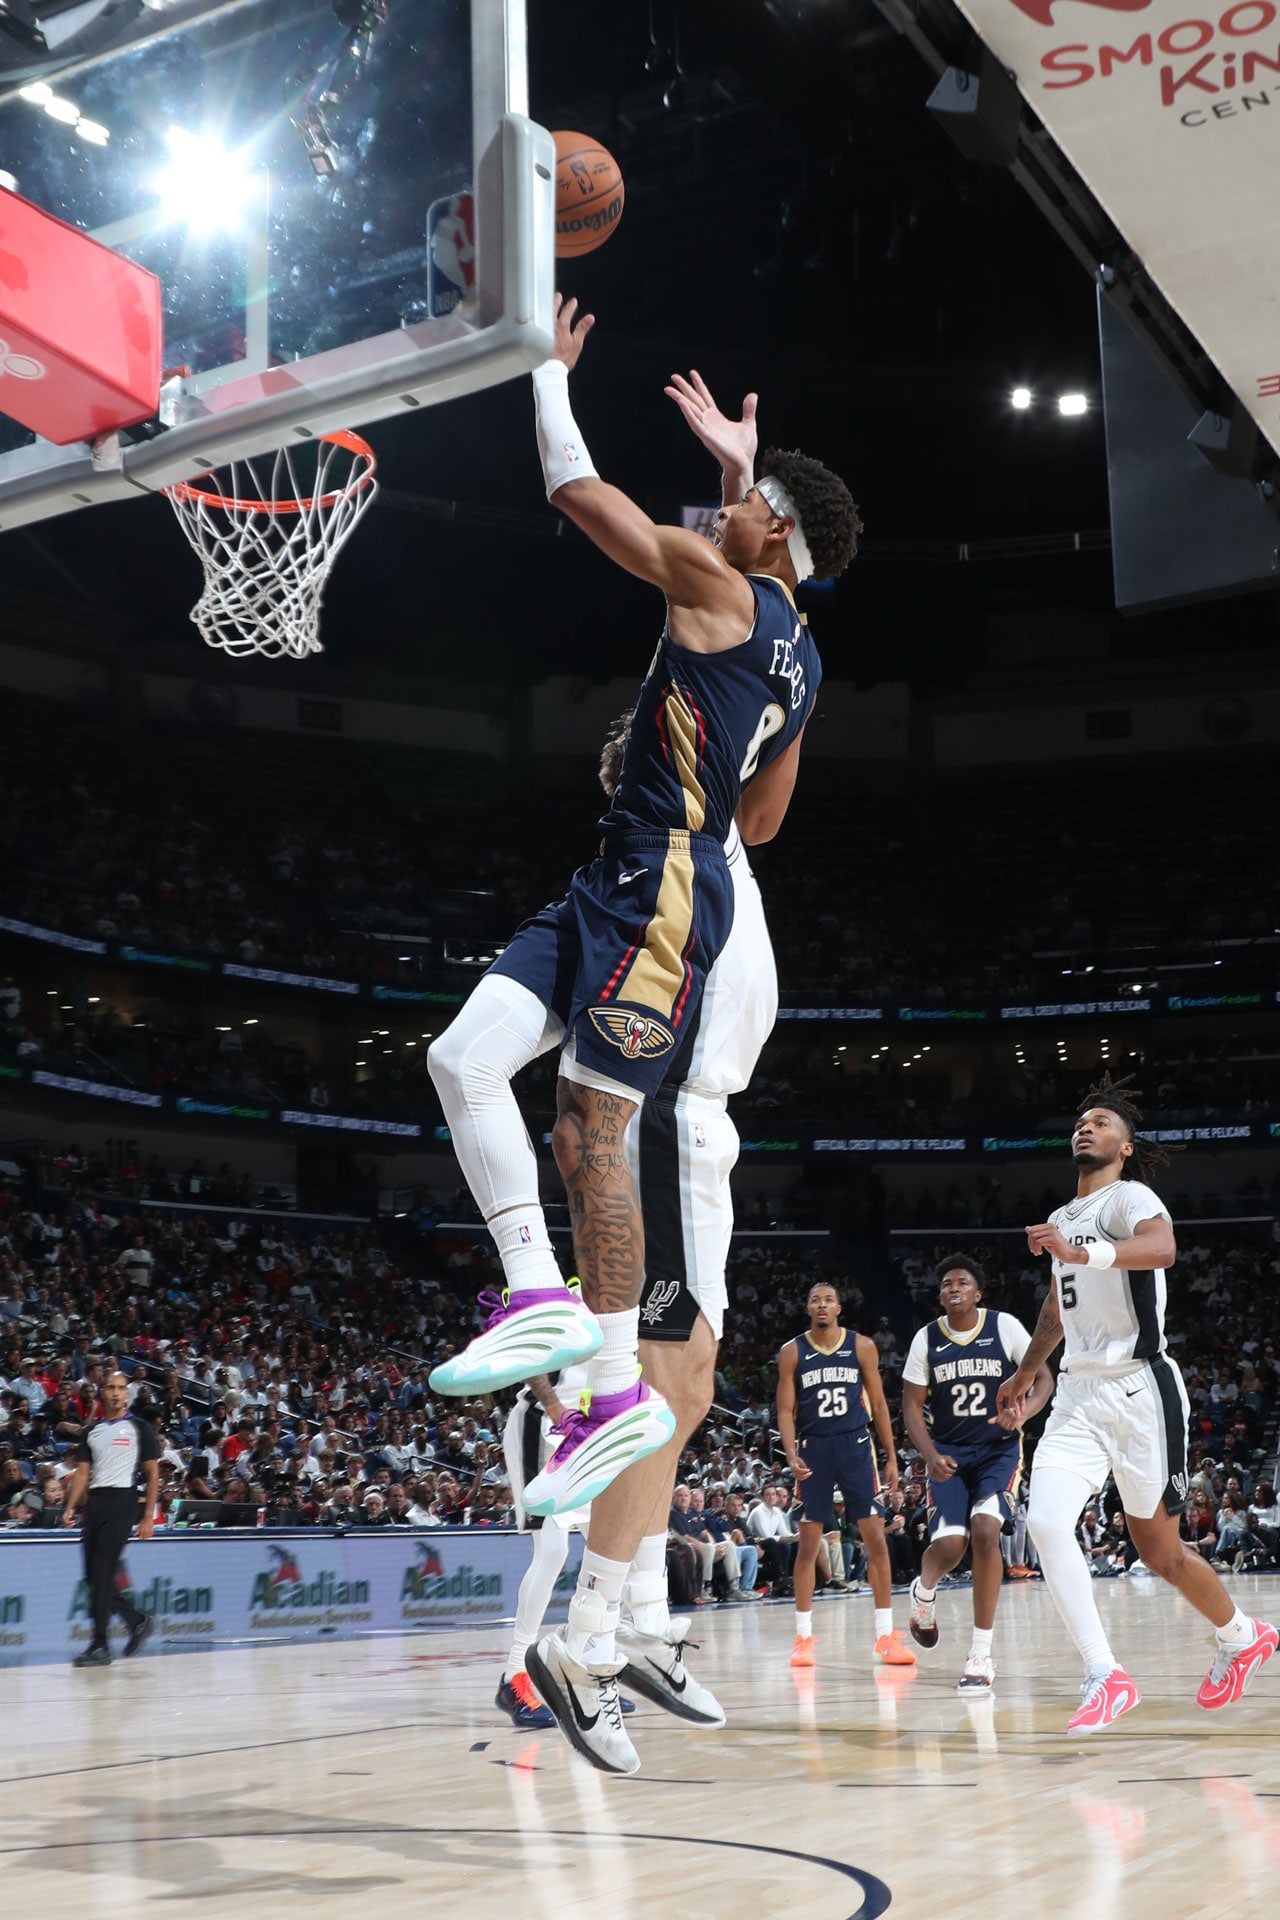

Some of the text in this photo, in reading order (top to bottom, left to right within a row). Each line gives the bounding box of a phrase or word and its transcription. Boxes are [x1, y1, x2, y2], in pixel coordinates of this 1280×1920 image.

[769, 639, 806, 710] FERS
[1060, 1273, 1077, 1310] 5
[801, 1367, 859, 1389] NEW ORLEANS
[933, 1358, 1003, 1384] NEW ORLEANS
[817, 1387, 848, 1418] 25
[951, 1382, 988, 1417] 22
[68, 1576, 214, 1620] Aadian
[249, 1570, 371, 1610] Acadian
[400, 1564, 504, 1602] Acadian
